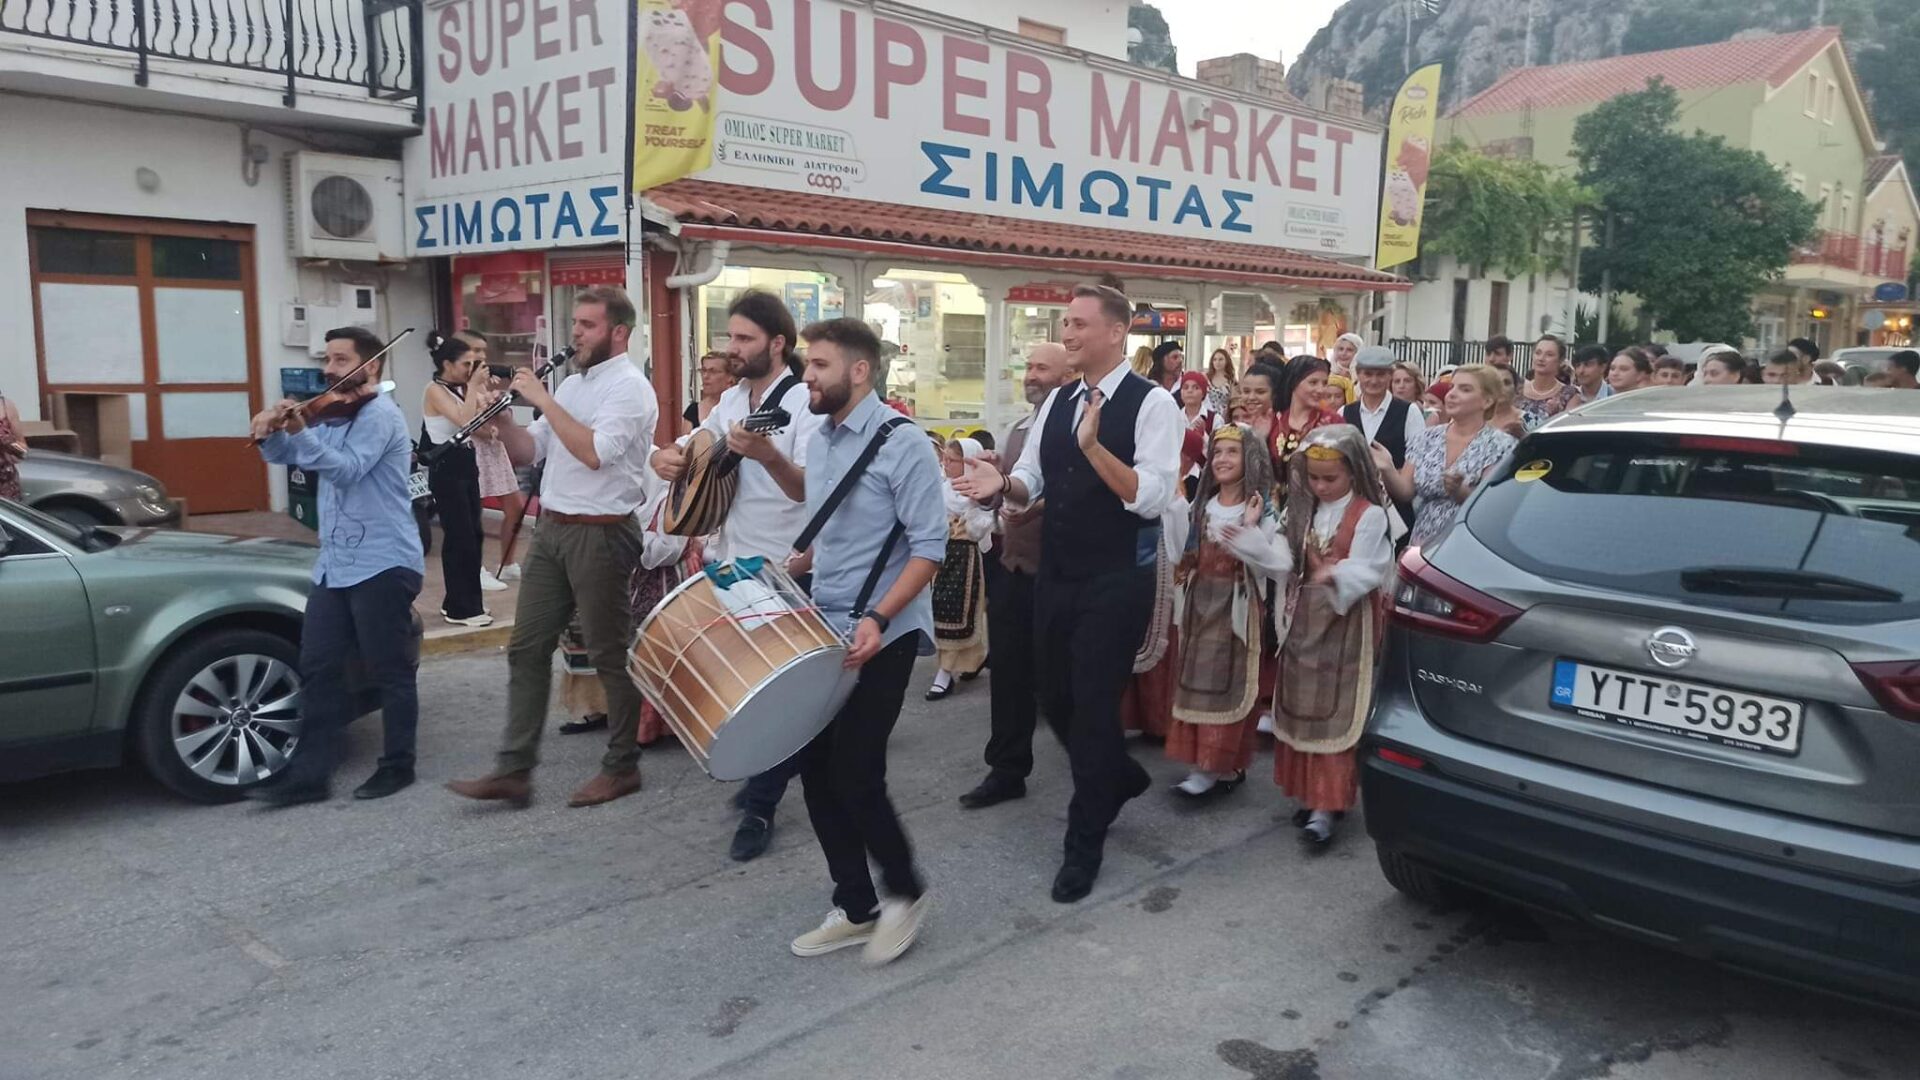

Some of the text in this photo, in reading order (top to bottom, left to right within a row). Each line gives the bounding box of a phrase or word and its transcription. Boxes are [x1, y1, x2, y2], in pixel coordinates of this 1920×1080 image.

[438, 0, 603, 84] SUPER
[718, 0, 1354, 197] SUPER MARKET
[429, 67, 616, 179] MARKET
[644, 123, 687, 137] TREAT
[644, 135, 707, 150] YOURSELF
[769, 125, 803, 147] SUPER
[805, 131, 846, 154] MARKET
[734, 150, 859, 176] ΕΛΛΗΝΙΚΗ ΔΙΑΤΡΟΦΗ
[806, 172, 843, 193] coop
[919, 141, 1254, 233] ΣΙΜΩΤΑΣ
[415, 186, 620, 248] ΣΙΜΩΤΑΣ
[1554, 686, 1573, 698] GR
[1590, 670, 1793, 742] YTT-5933
